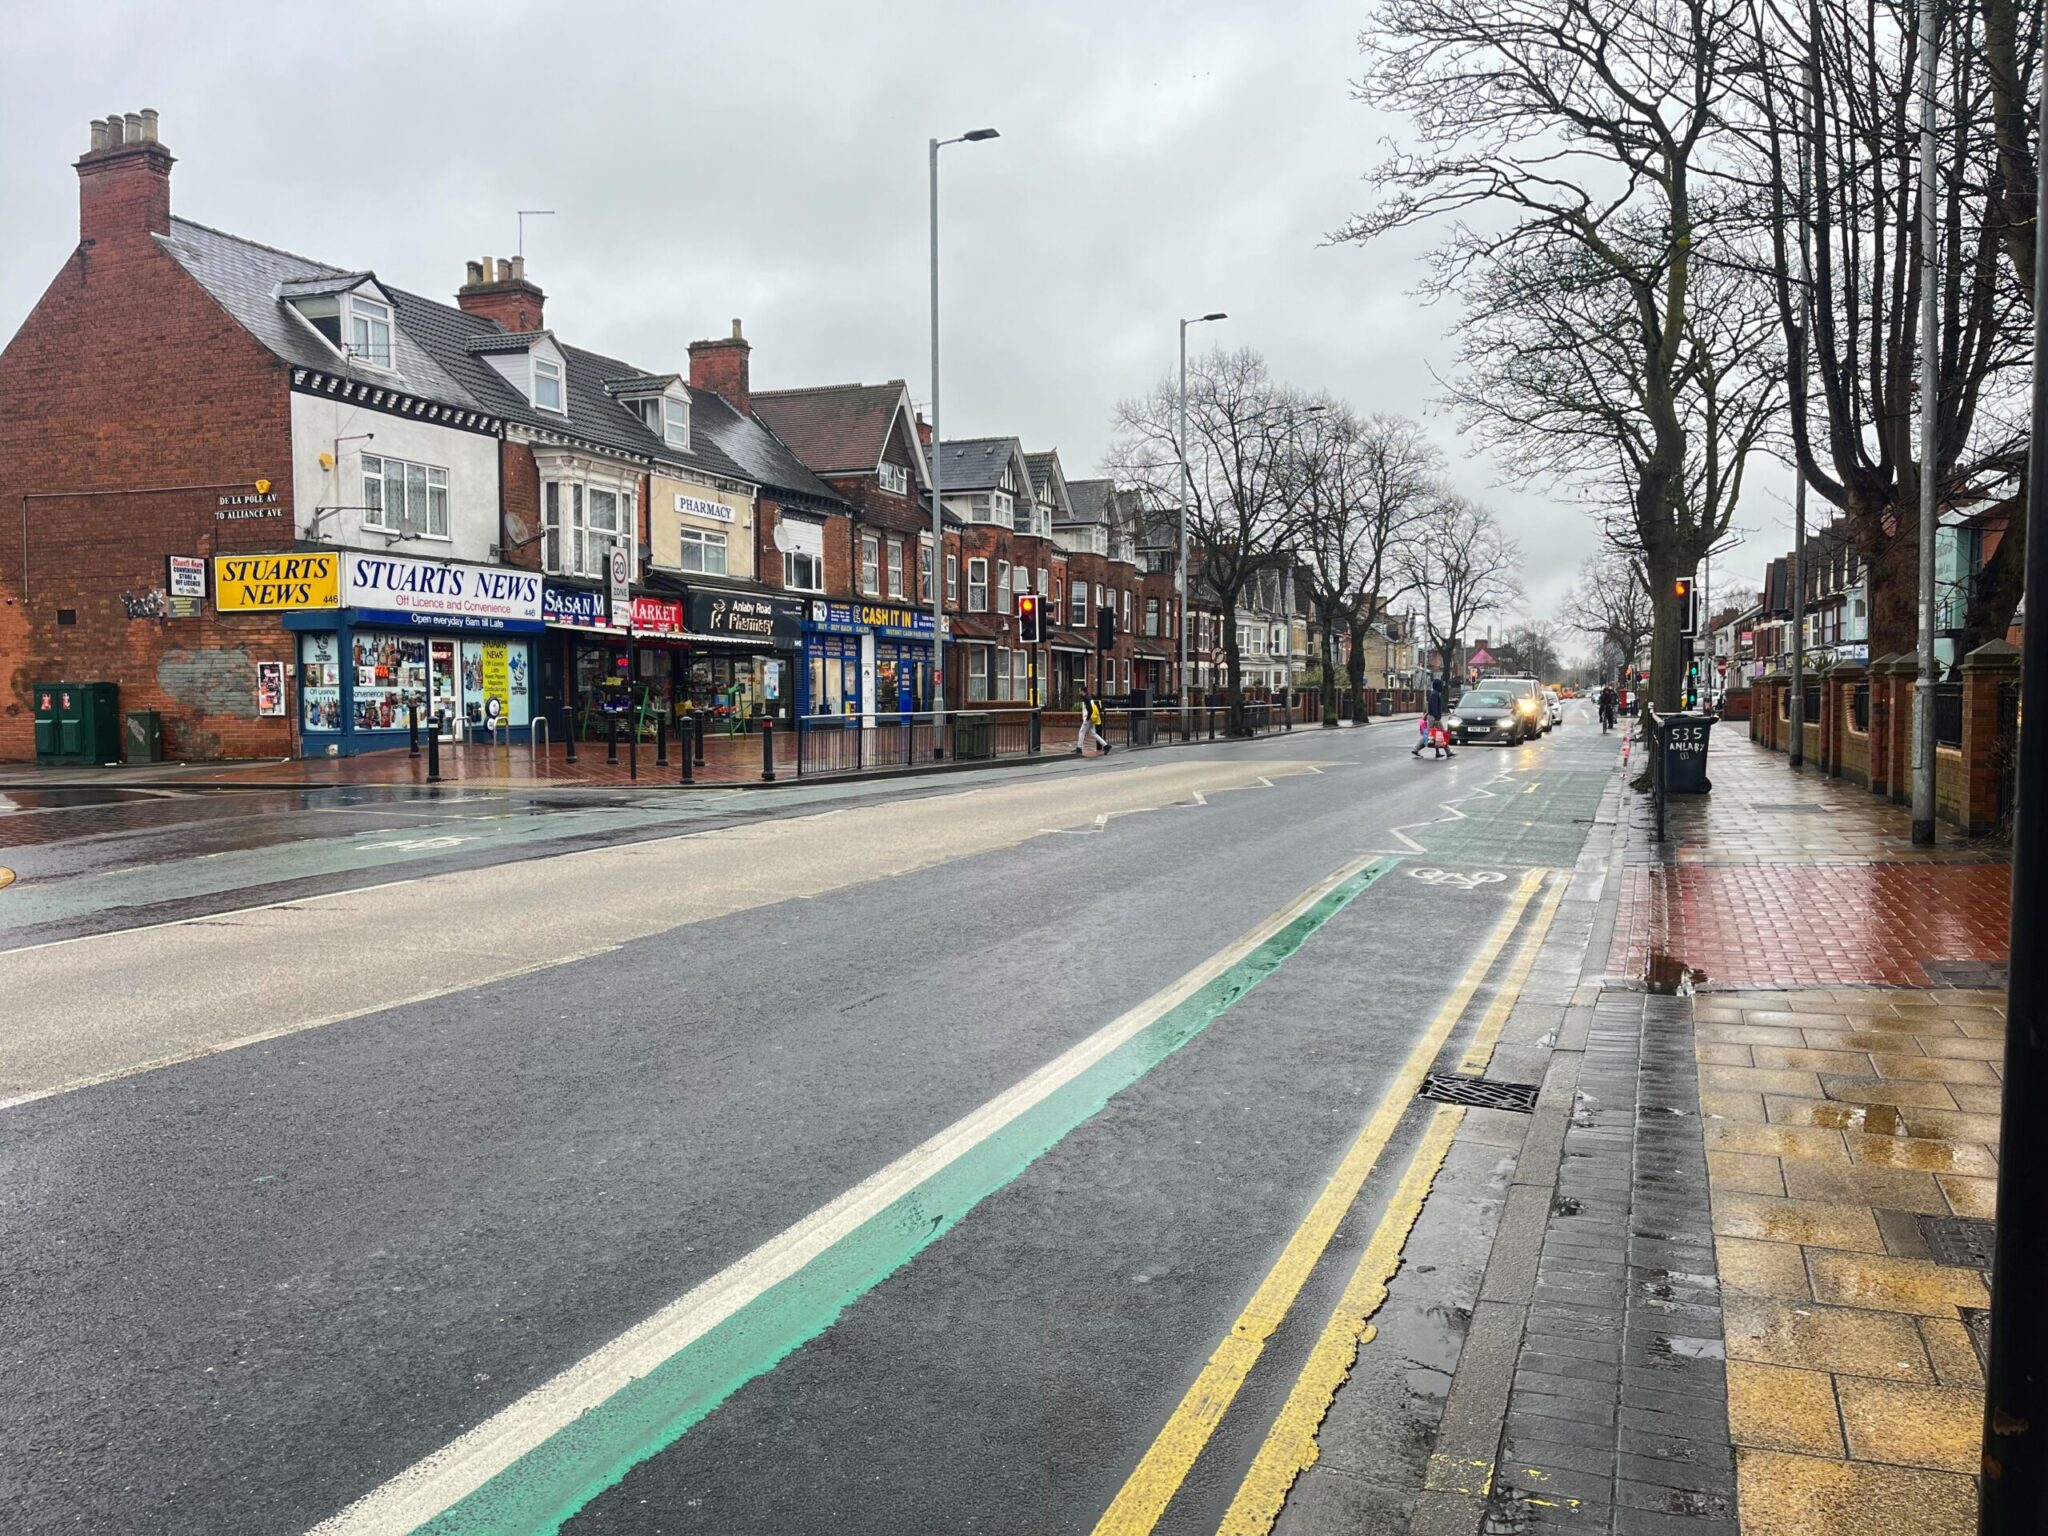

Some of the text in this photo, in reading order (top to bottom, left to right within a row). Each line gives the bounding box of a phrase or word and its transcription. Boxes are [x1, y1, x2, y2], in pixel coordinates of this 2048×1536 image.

[220, 497, 230, 505] DE
[232, 496, 242, 504] LA
[245, 495, 263, 504] POLE
[215, 508, 282, 520] TO ALLIANCE AVE
[680, 497, 732, 519] PHARMACY
[173, 567, 202, 575] CONVENIENCE
[223, 558, 330, 582] STUARTS
[615, 561, 624, 575] 20
[353, 559, 538, 602] STUARTS NEWS
[240, 583, 311, 605] NEWS
[323, 594, 338, 603] 446
[613, 587, 627, 597] ZONE
[396, 594, 511, 614] Off Licence and Convenience
[544, 589, 591, 615] SASAN
[629, 598, 677, 621] MARKET
[733, 600, 771, 615] Anlaby Road
[411, 613, 504, 628] Open everyday 6am till Late
[729, 613, 774, 635] Pharmacy
[862, 606, 889, 626] CASH
[891, 609, 899, 626] IT
[902, 611, 911, 628] IN
[486, 651, 504, 659] NEWS
[1672, 727, 1703, 741] 535
[1669, 742, 1705, 752] ANLABY
